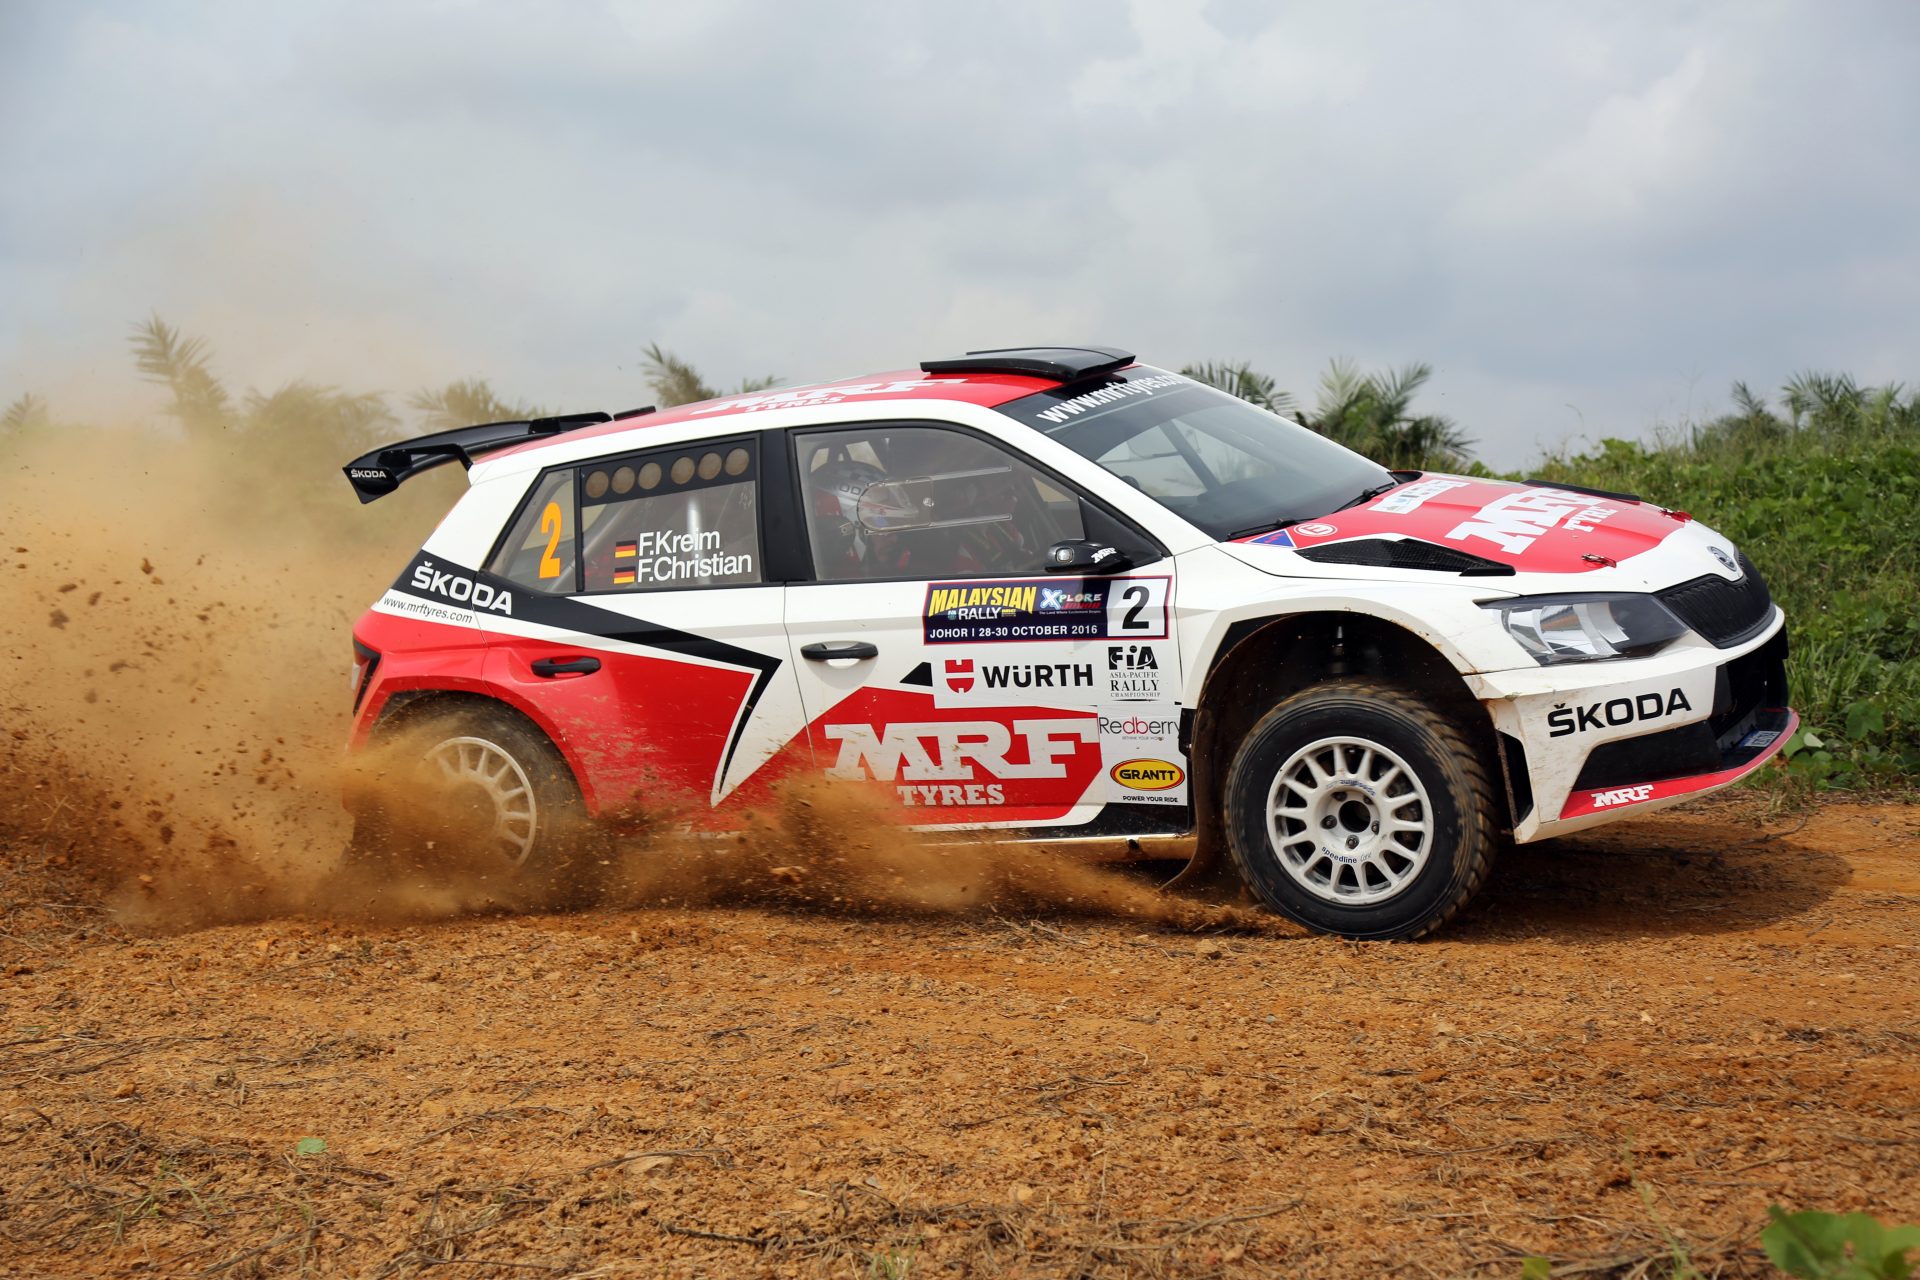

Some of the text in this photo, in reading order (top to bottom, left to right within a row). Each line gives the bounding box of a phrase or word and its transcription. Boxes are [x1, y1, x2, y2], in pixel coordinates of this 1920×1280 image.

[539, 502, 562, 578] 2
[639, 528, 720, 556] F.Kreim
[637, 551, 752, 583] F.Christian
[411, 561, 512, 615] ŠKODA
[383, 596, 473, 624] www.mrftyres.com
[928, 586, 1037, 618] MALAYSIAN
[958, 607, 1002, 620] RALLY
[1122, 586, 1150, 629] 2
[930, 628, 968, 639] JOHOR
[979, 626, 1009, 637] 28-30
[1012, 625, 1068, 636] OCTOBER
[1071, 625, 1098, 635] 2016
[982, 664, 1093, 688] WÜRTH
[1110, 671, 1159, 679] ASIA-PACIFIC
[1111, 679, 1159, 692] RALLY
[1548, 687, 1692, 738] ŠKODA
[824, 717, 1100, 782] MRF
[1119, 769, 1175, 780] GRANTT
[897, 784, 1005, 806] TYRES
[1591, 784, 1654, 808] MRF
[1321, 846, 1358, 864] speedline
